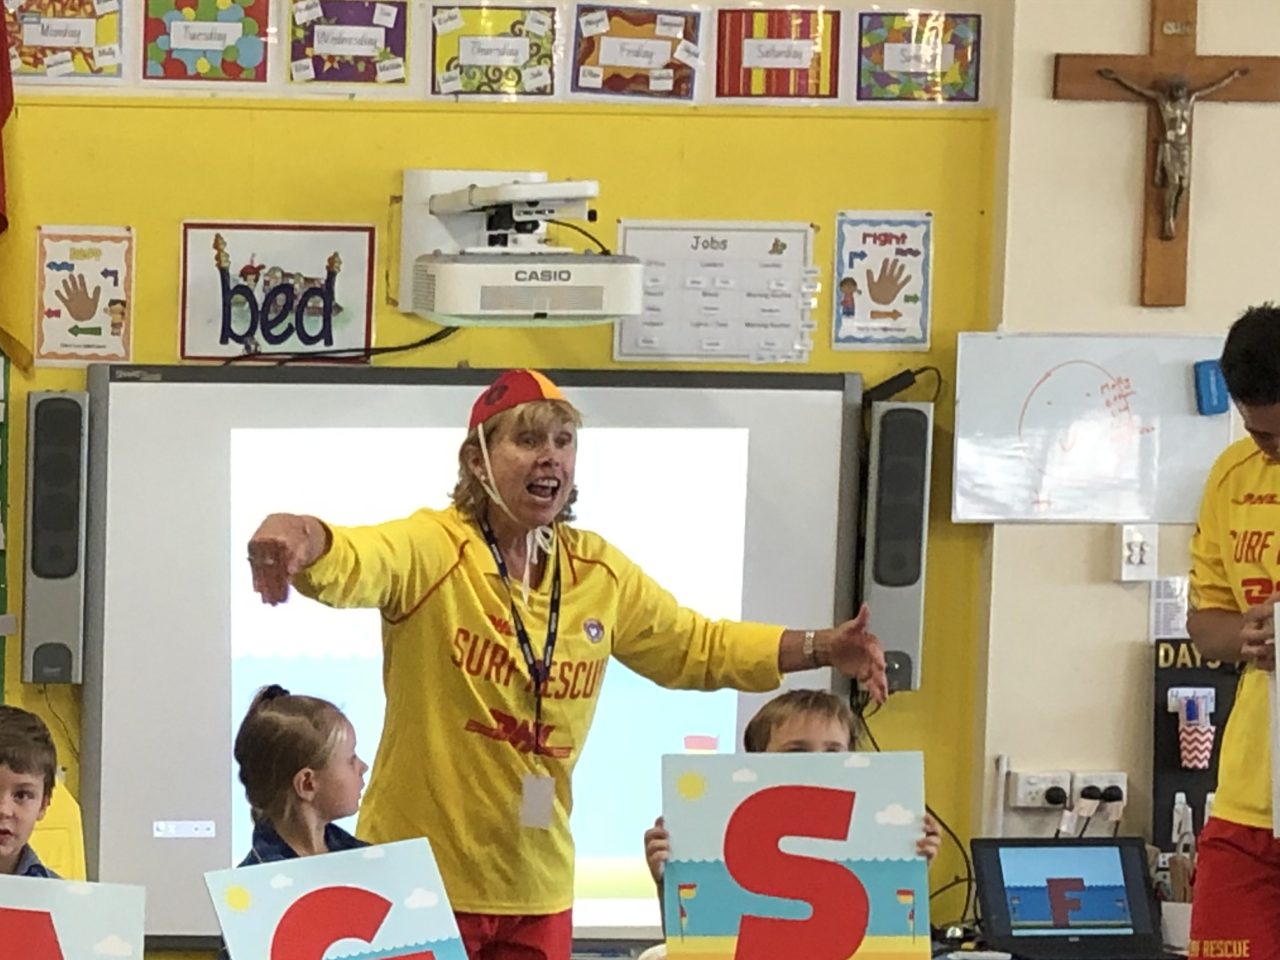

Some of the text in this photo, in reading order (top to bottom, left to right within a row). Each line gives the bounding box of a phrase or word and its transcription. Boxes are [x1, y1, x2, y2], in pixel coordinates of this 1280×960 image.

[40, 23, 82, 44] Monday
[182, 25, 227, 47] Tuesday
[756, 43, 803, 63] Saturday
[690, 235, 729, 251] Jobs
[514, 270, 571, 282] CASIO
[216, 245, 338, 347] bed
[1046, 877, 1086, 928] F
[1203, 940, 1251, 958] RESCUE
